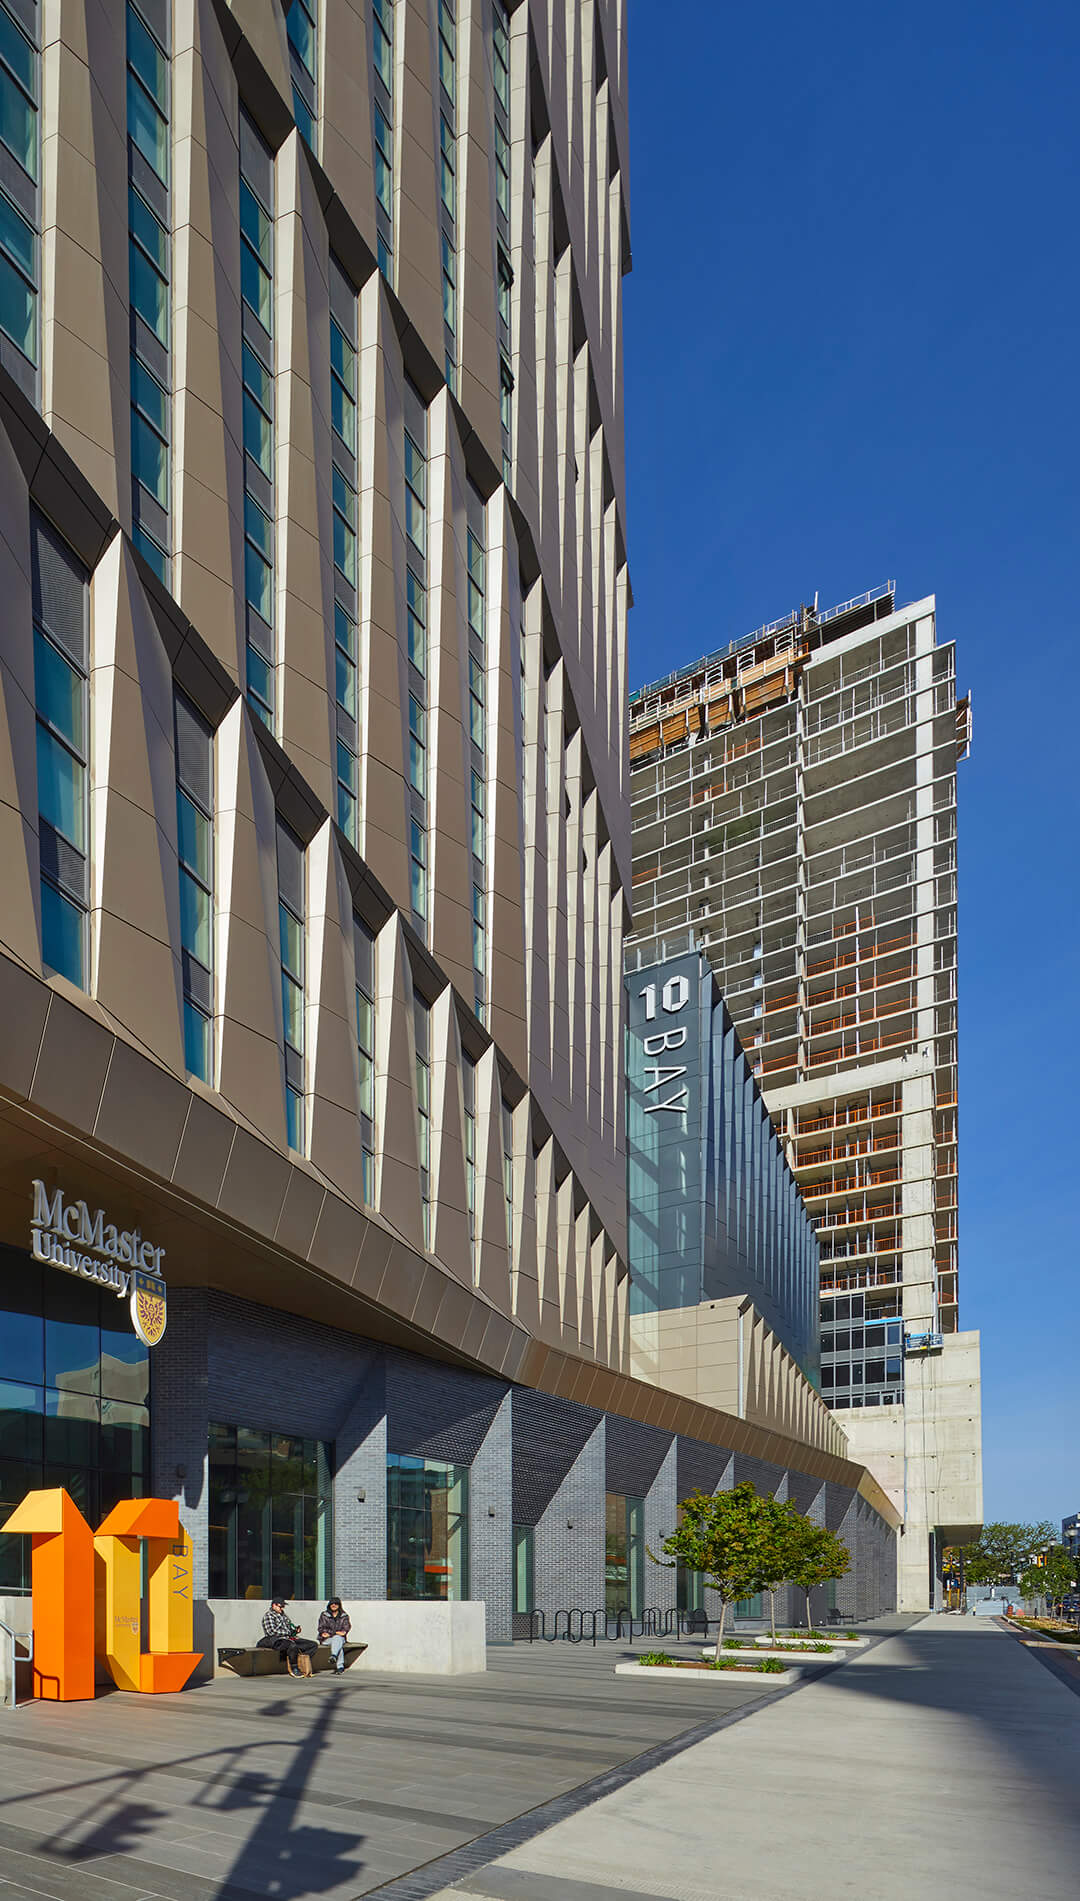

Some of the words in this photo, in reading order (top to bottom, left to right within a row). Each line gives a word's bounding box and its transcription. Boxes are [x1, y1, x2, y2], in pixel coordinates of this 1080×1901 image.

[638, 975, 689, 1021] 10
[643, 1026, 689, 1113] BAY
[30, 1178, 166, 1276] McMaster
[30, 1228, 132, 1298] University
[172, 1544, 189, 1599] BAY
